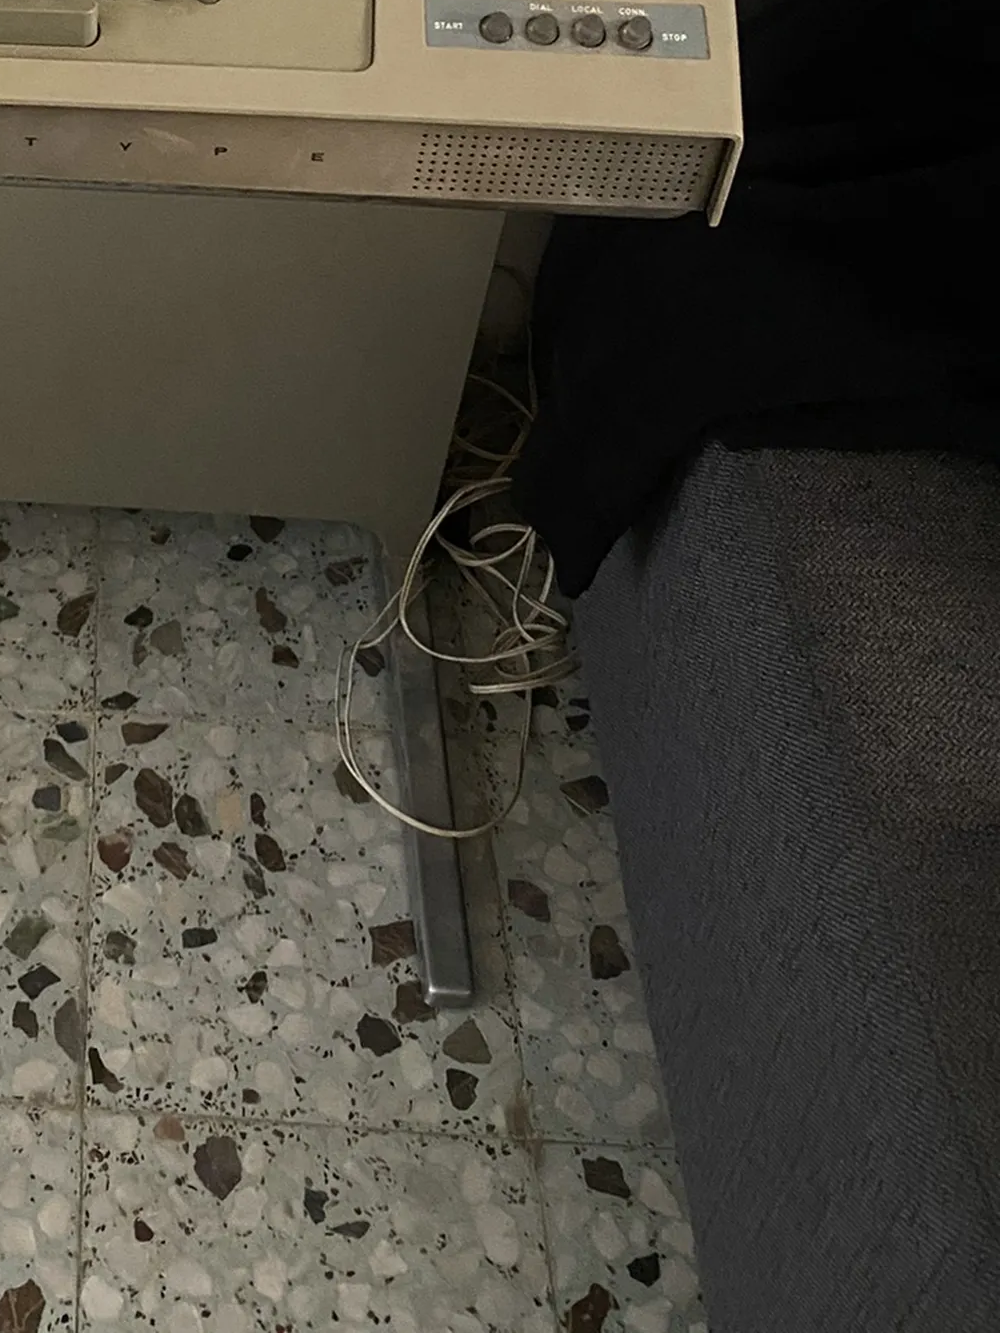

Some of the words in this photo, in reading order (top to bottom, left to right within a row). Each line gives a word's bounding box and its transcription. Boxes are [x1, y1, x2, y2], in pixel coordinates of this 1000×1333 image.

[528, 2, 554, 12] DIAL
[571, 5, 604, 14] LOCAL
[434, 20, 464, 30] START
[662, 32, 688, 42] STOP
